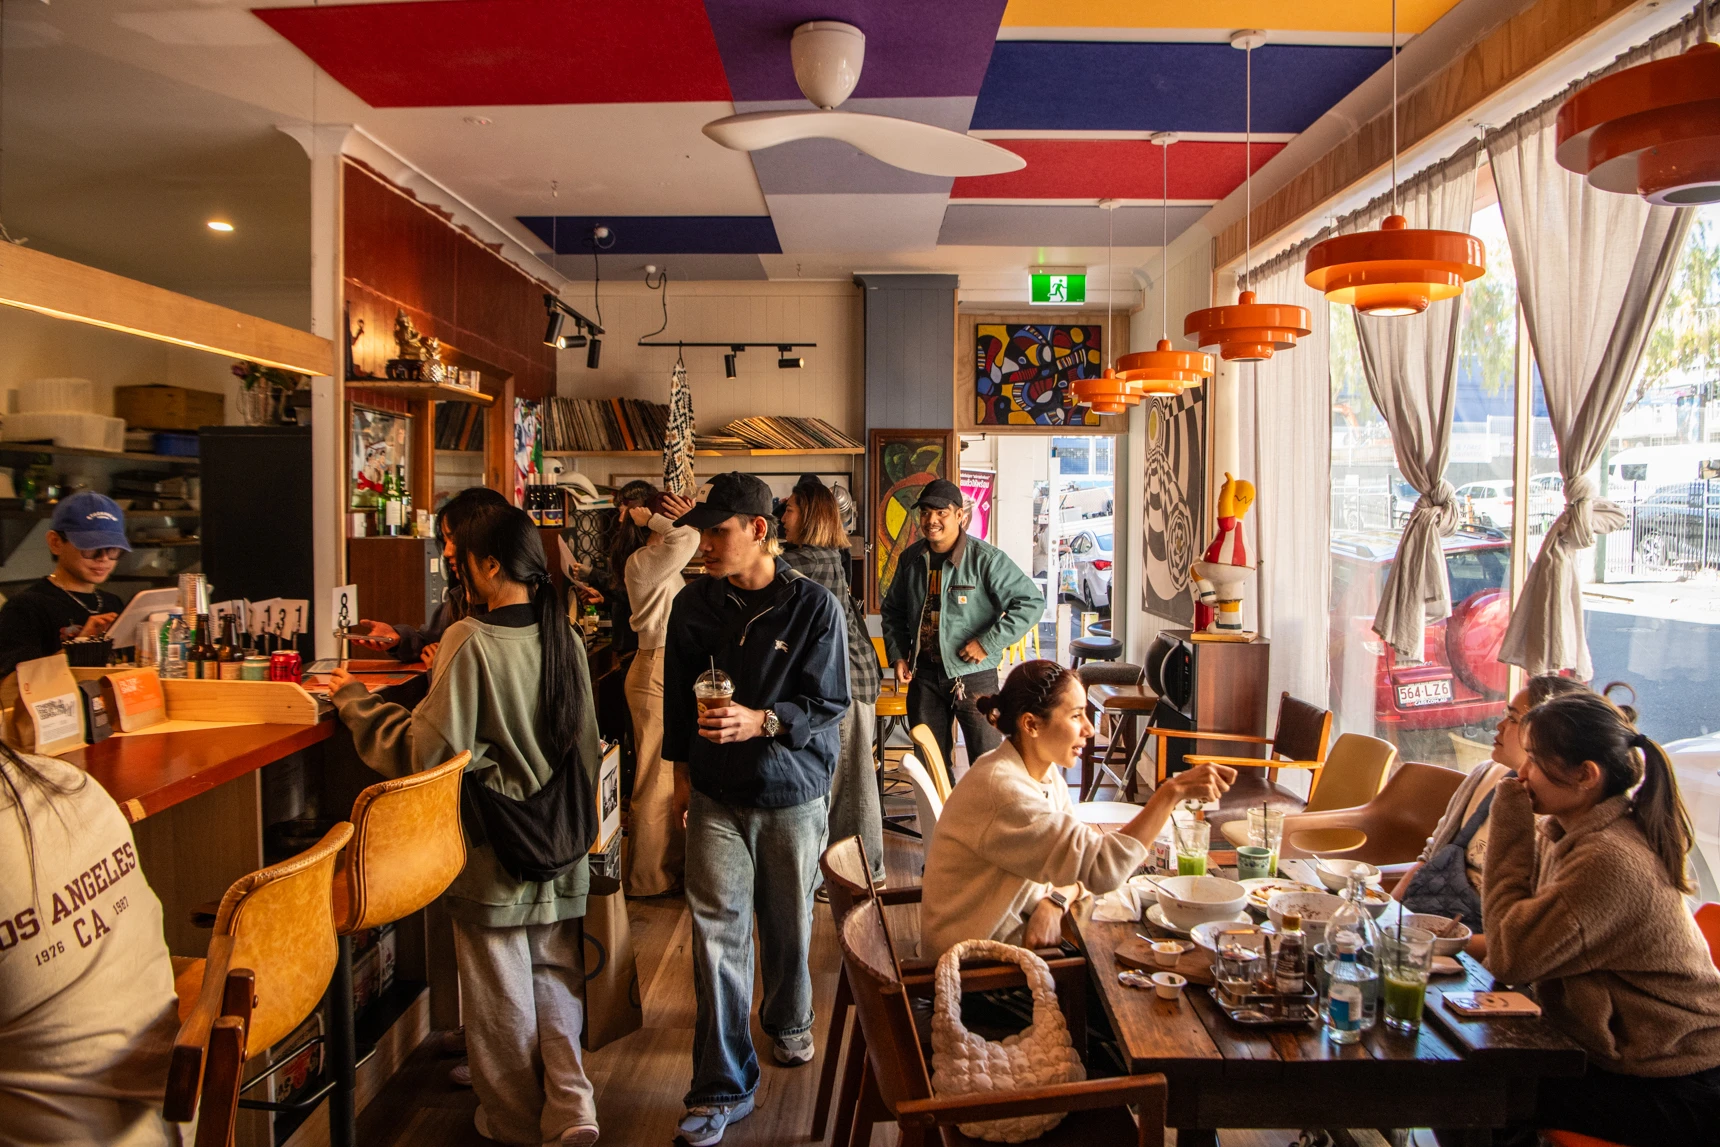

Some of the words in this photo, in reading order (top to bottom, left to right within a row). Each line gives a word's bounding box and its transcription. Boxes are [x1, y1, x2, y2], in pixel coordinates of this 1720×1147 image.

[51, 841, 136, 926] ANGELES
[35, 941, 65, 966] 1976
[73, 909, 110, 949] CA
[112, 896, 130, 915] 1987
